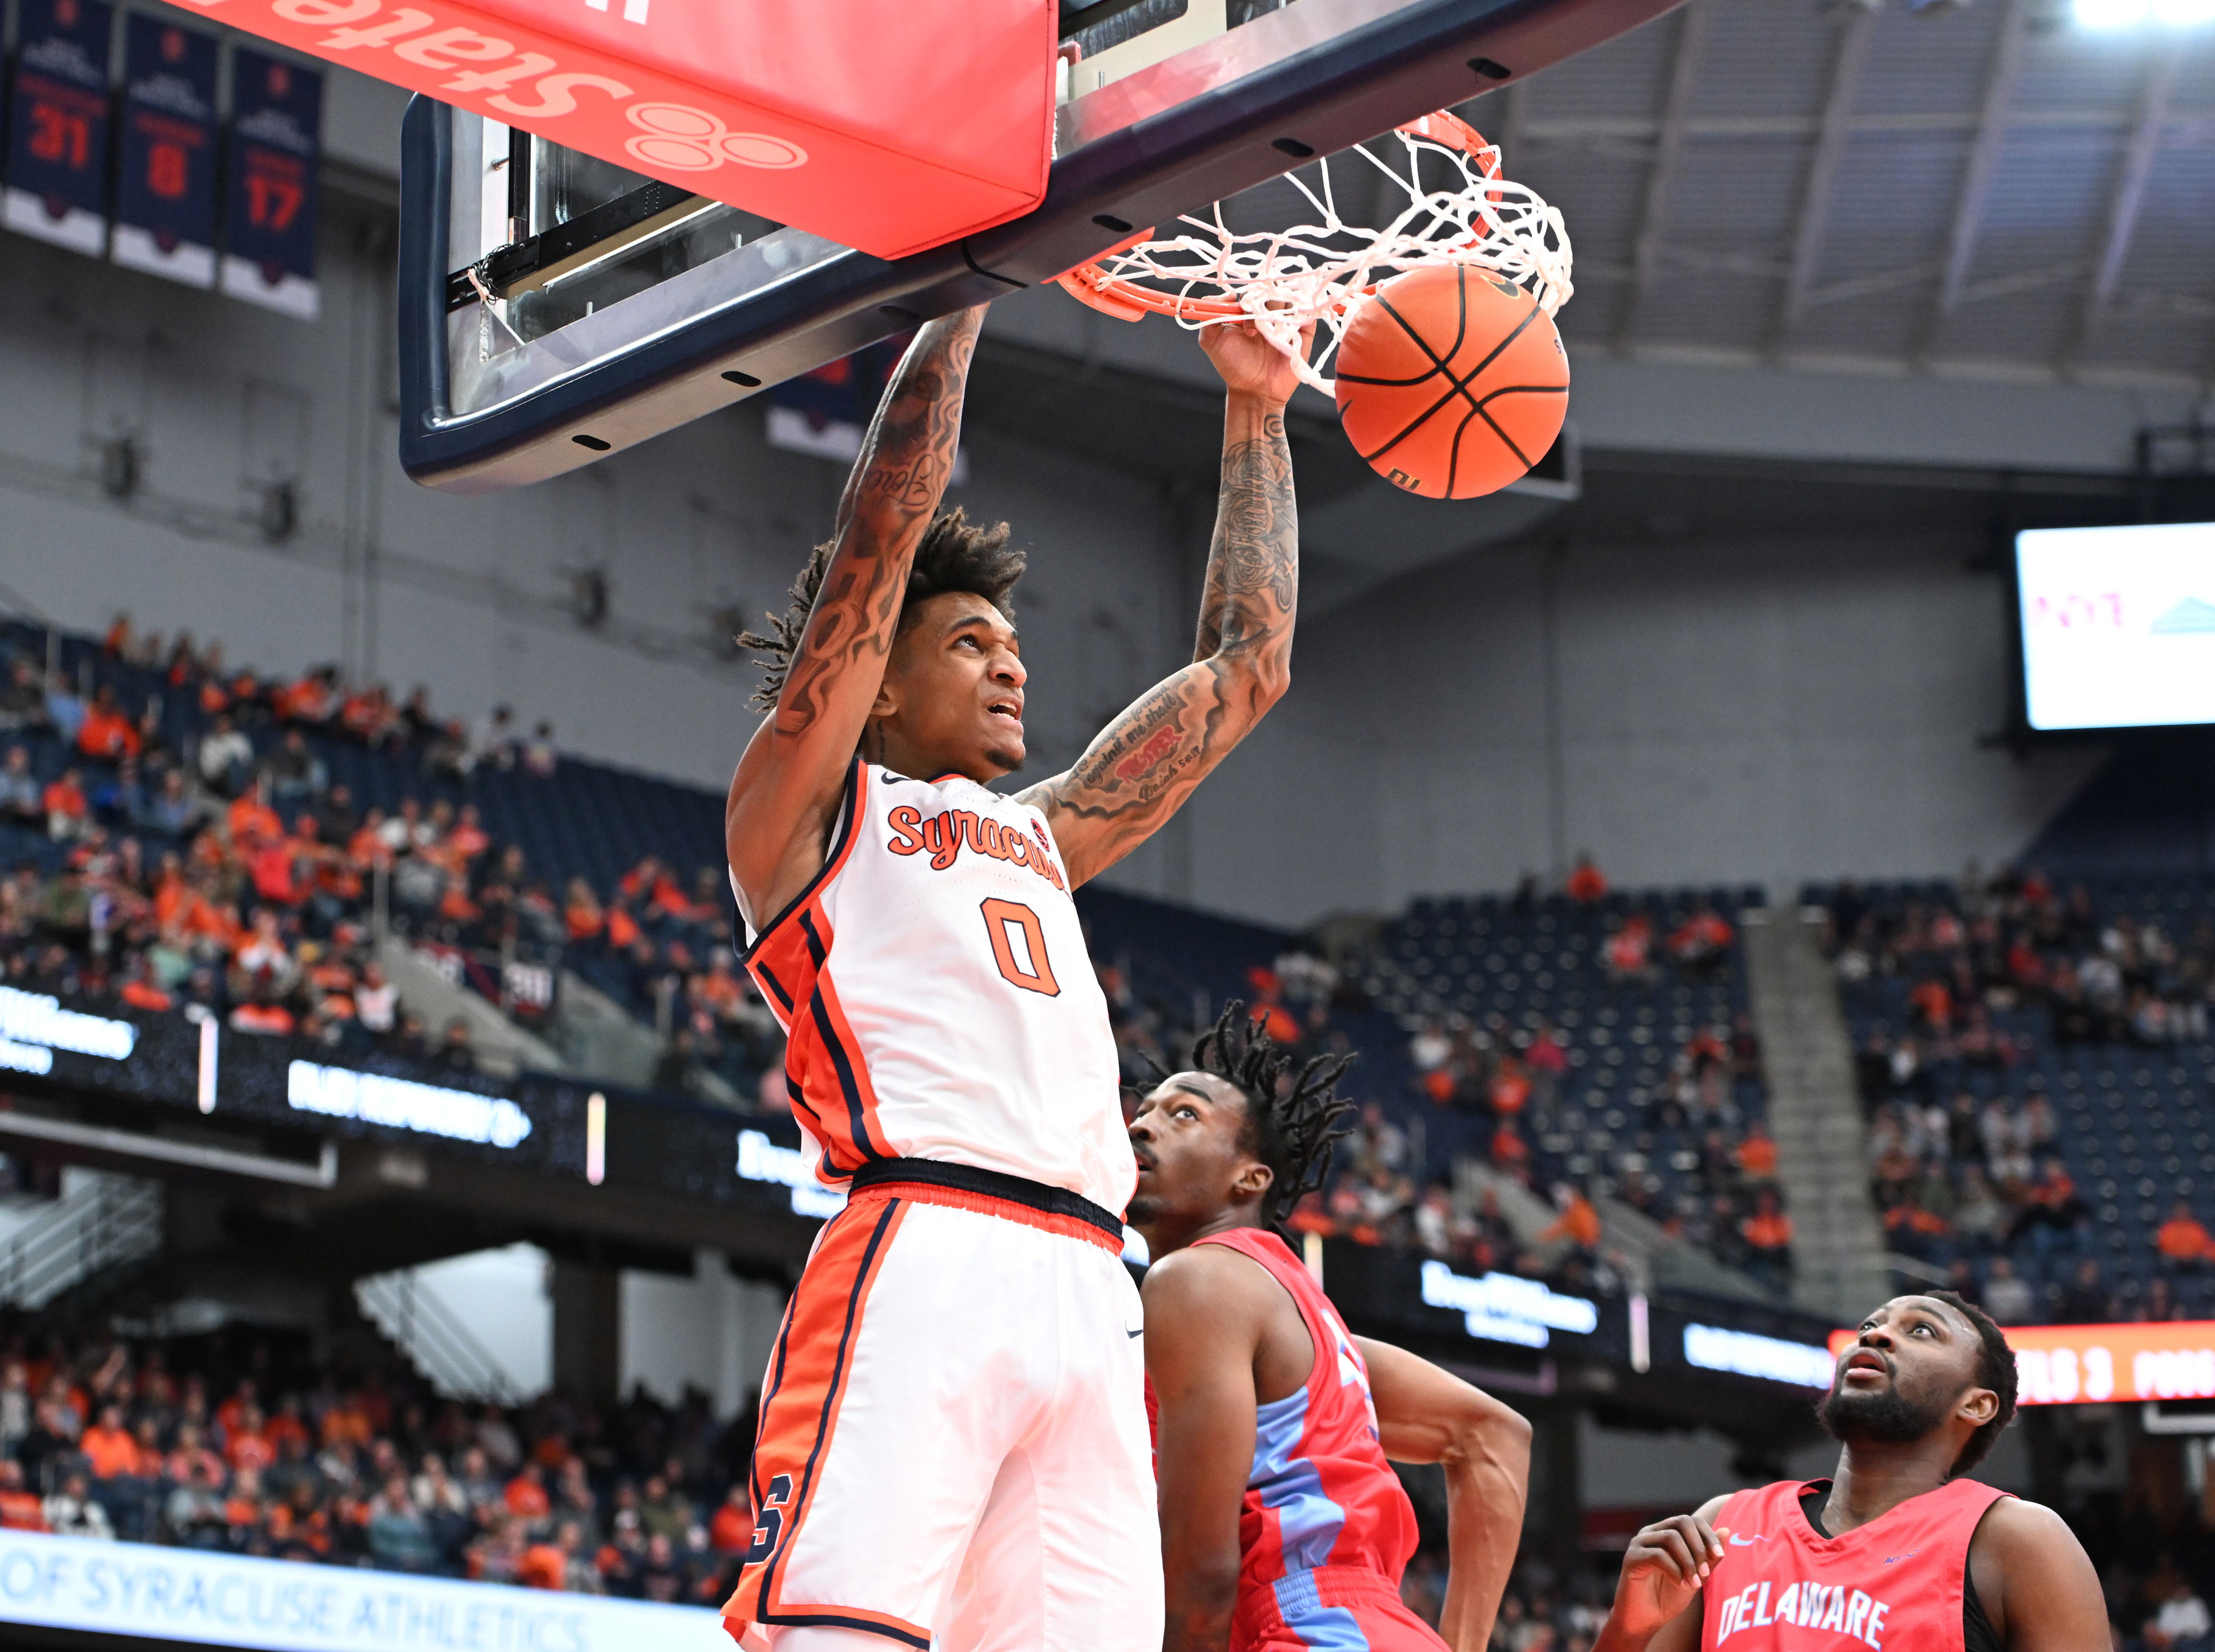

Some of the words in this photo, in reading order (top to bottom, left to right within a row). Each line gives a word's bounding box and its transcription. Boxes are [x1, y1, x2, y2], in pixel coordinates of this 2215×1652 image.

[979, 897, 1062, 998] 0
[81, 1557, 336, 1636] SYRACUSE
[345, 1591, 592, 1652] ATHLETICS
[1717, 1581, 1890, 1652] DELAWARE
